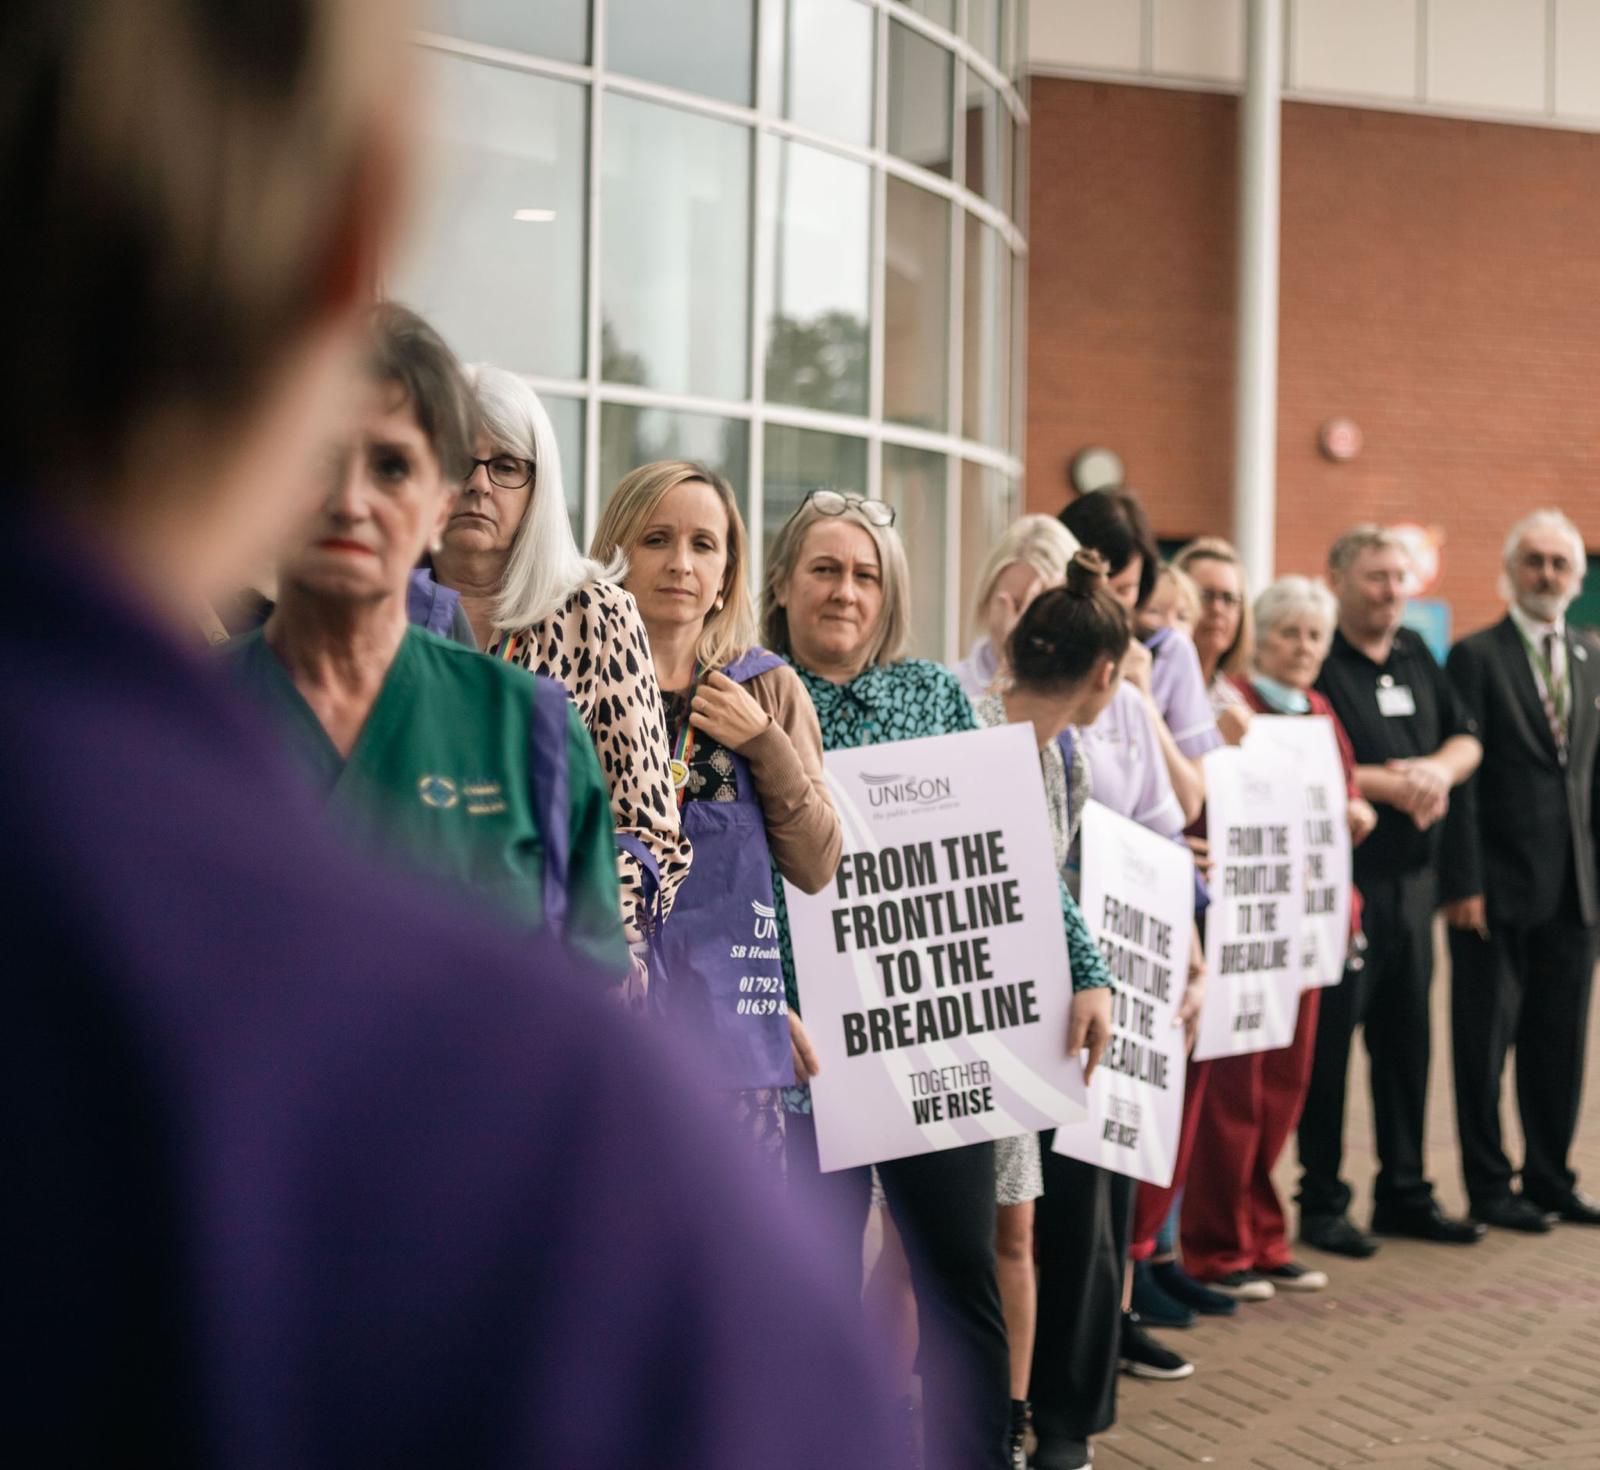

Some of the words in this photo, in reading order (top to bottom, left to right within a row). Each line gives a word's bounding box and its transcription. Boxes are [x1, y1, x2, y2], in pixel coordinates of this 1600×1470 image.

[868, 776, 951, 807] UNISON
[836, 842, 938, 899] FROM
[941, 831, 1008, 880] THE
[832, 880, 1023, 953] FRONTLINE
[1103, 894, 1144, 946] FROM
[1148, 916, 1171, 959] THE
[730, 945, 747, 958] SB
[876, 950, 922, 998] TO
[927, 937, 993, 989] THE
[739, 976, 779, 993] 01792
[736, 998, 776, 1015] 01639
[842, 981, 1040, 1058] BREADLINE
[1132, 998, 1154, 1040] THE
[908, 1060, 991, 1098] TOGETHER
[912, 1095, 944, 1126] WE
[947, 1086, 994, 1120] RISE
